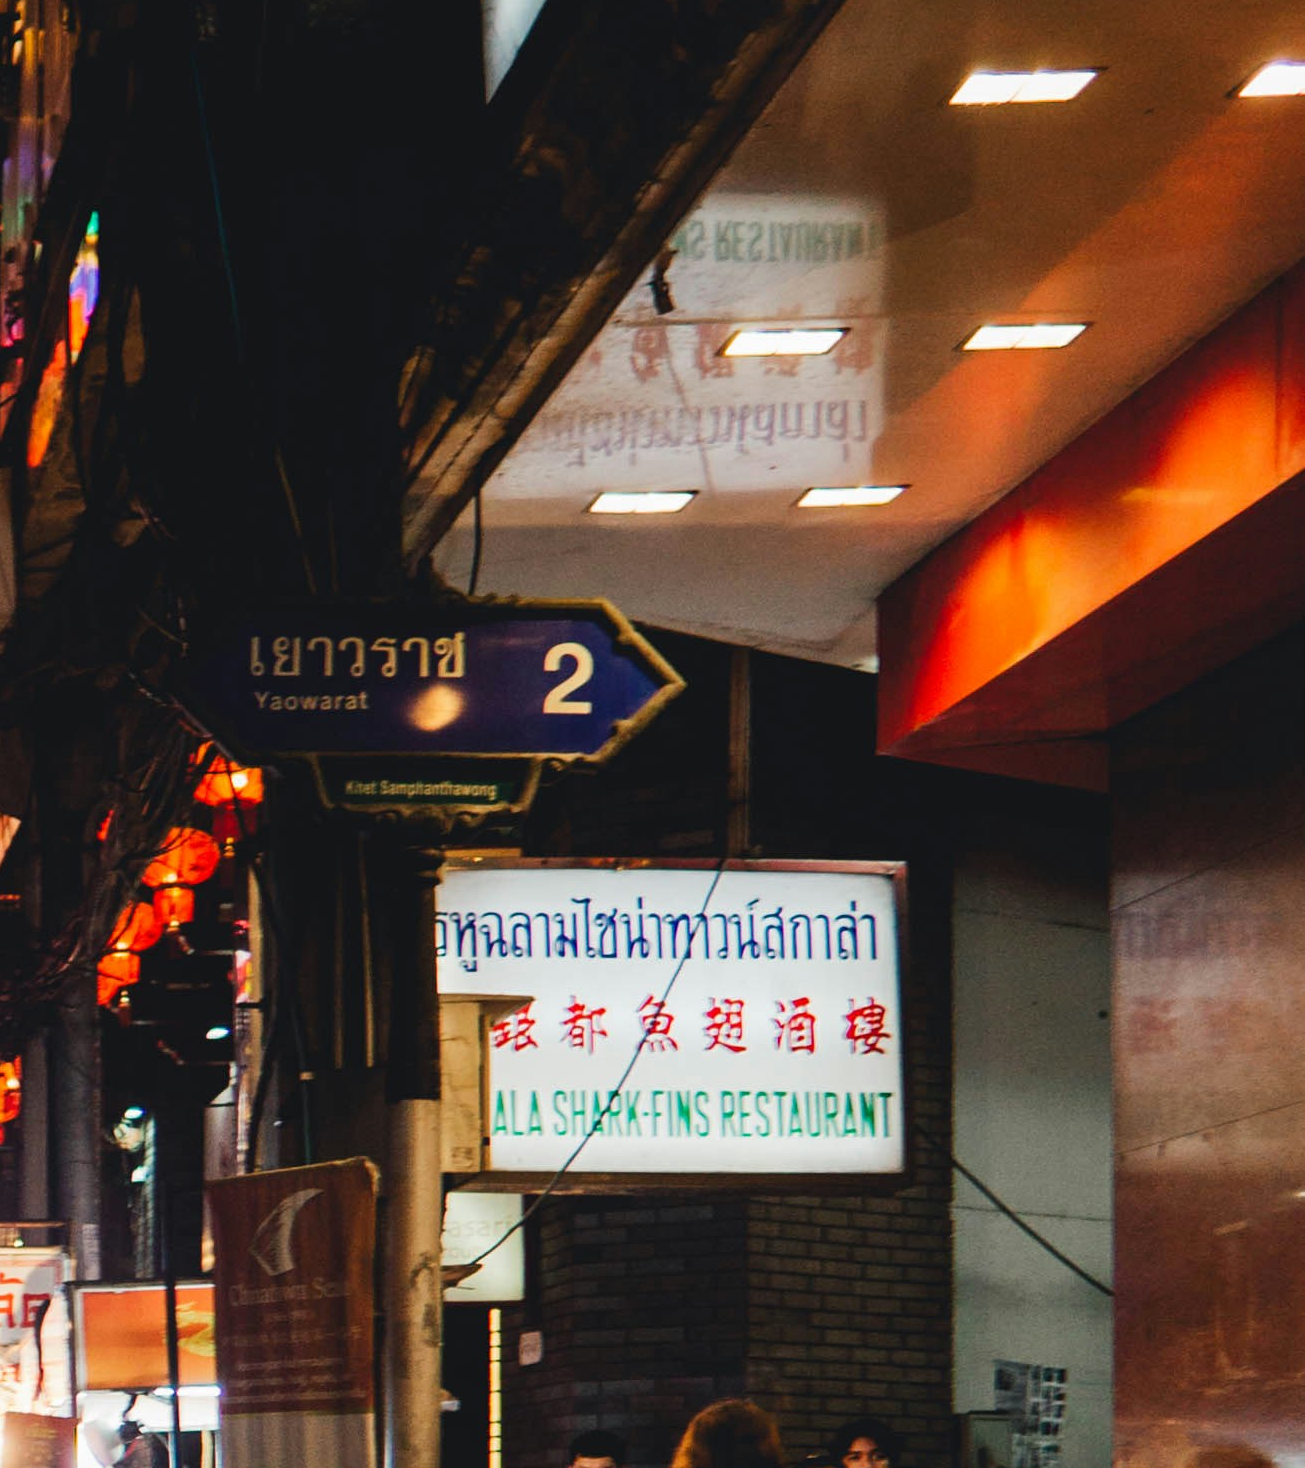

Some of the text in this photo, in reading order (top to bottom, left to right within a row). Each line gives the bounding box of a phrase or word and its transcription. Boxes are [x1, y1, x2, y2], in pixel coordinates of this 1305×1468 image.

[248, 631, 468, 679] เยาวราช
[542, 641, 596, 715] 2
[253, 690, 369, 712] Yaowarat
[494, 1089, 894, 1139] ALA SHARK-FINS RESTAURANT
